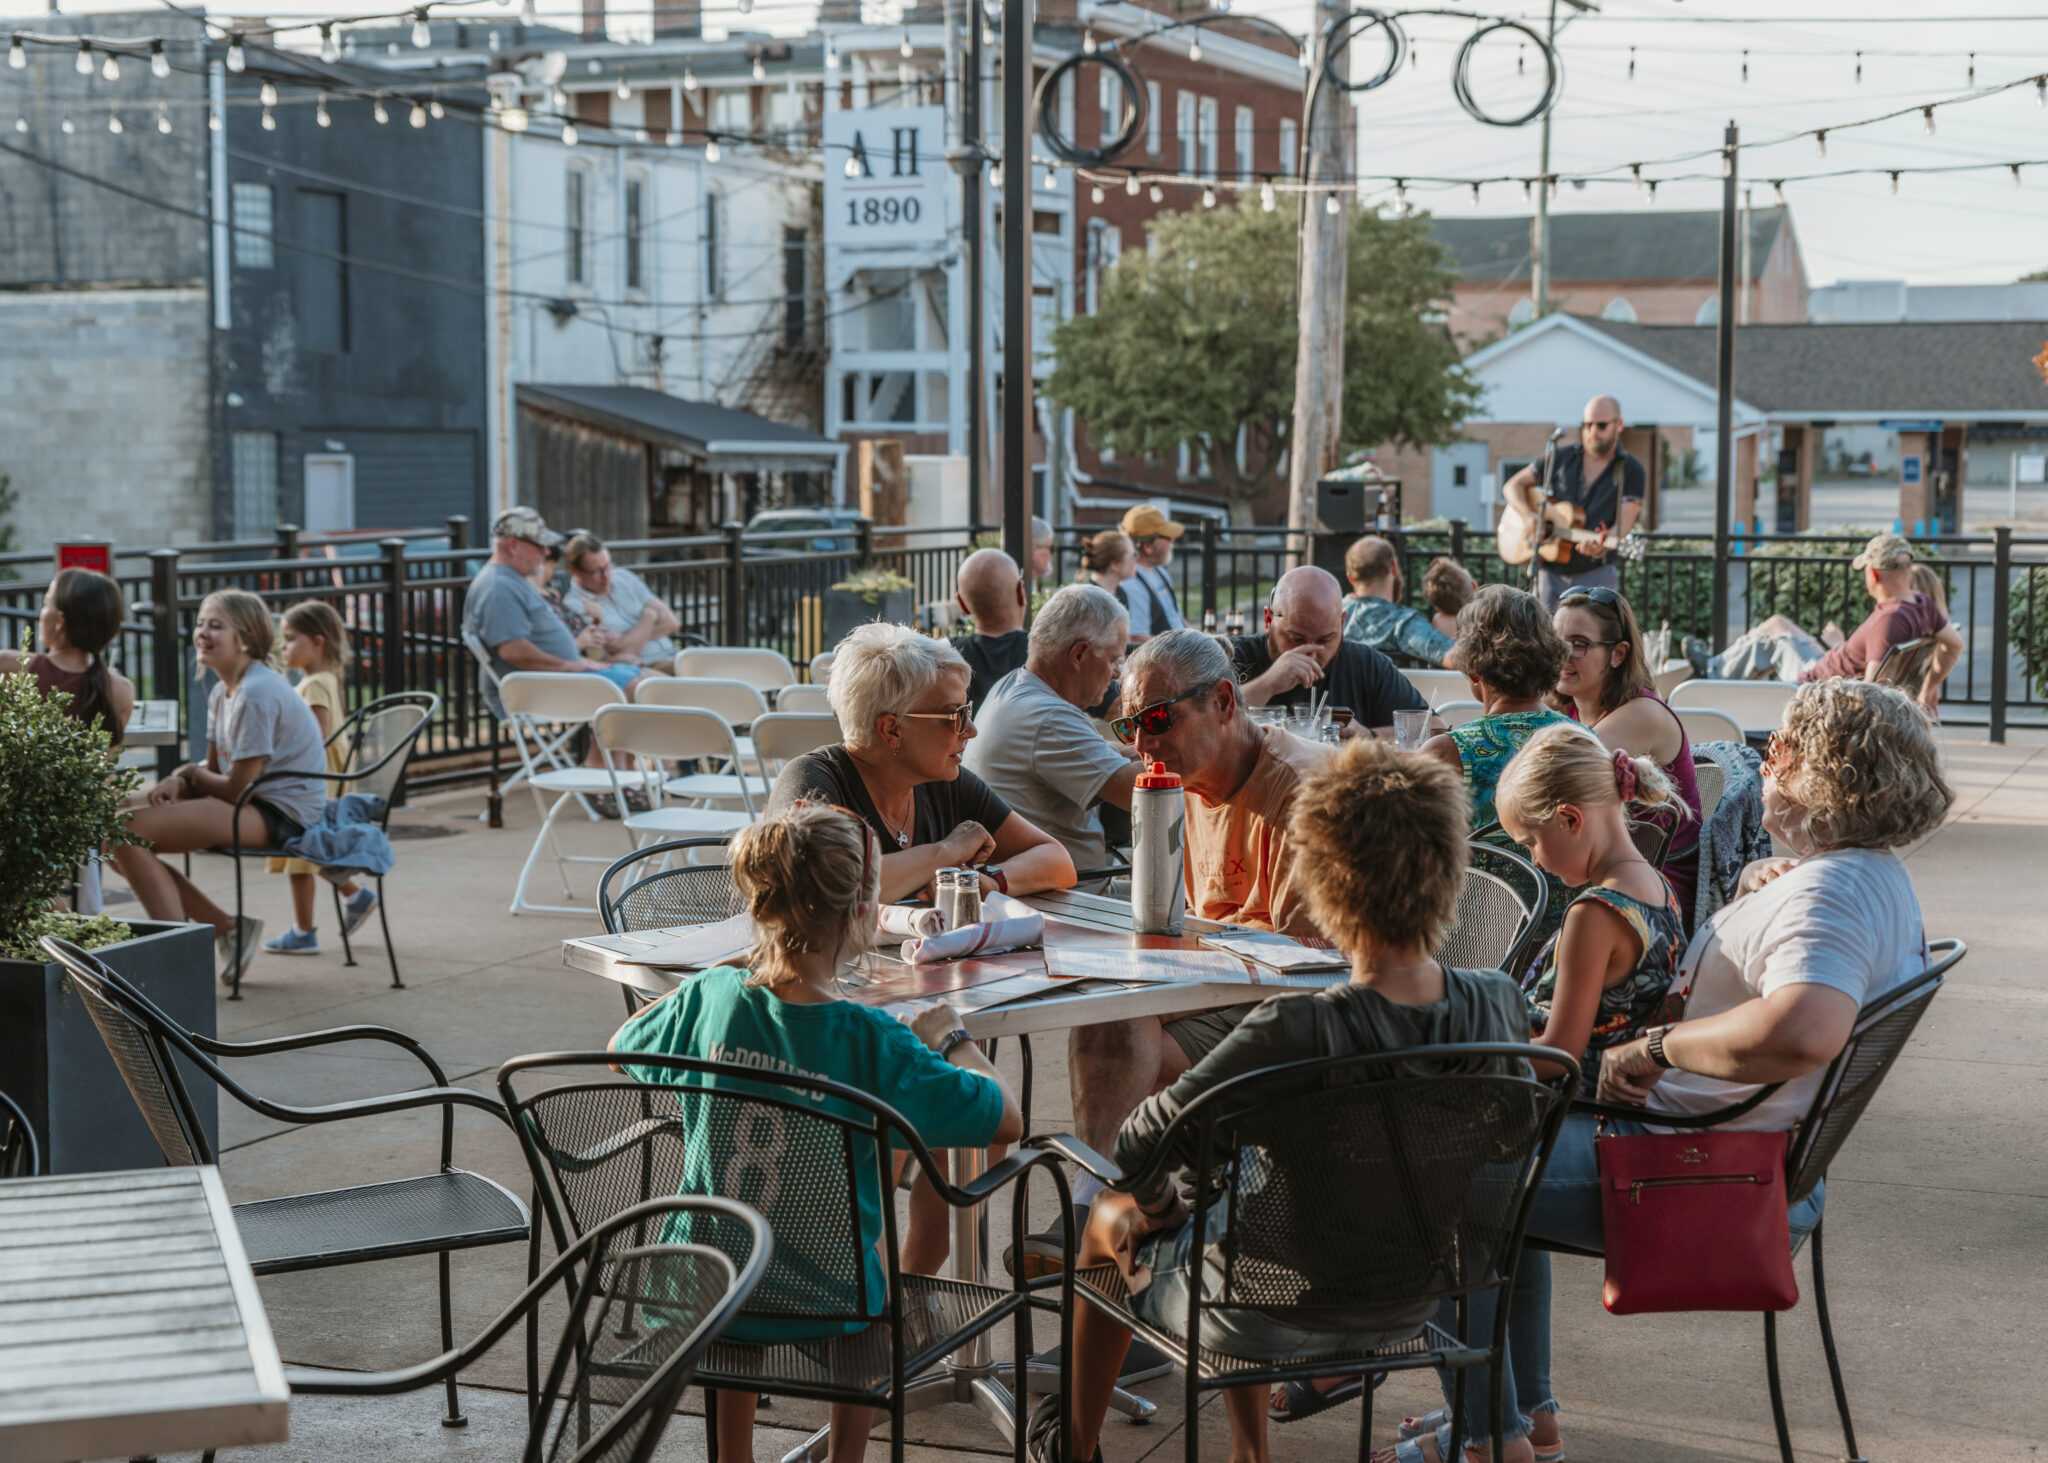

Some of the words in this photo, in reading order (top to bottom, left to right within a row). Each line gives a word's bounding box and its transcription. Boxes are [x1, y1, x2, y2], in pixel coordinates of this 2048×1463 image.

[844, 129, 873, 178] A
[891, 128, 920, 177] H
[846, 197, 921, 225] 1890
